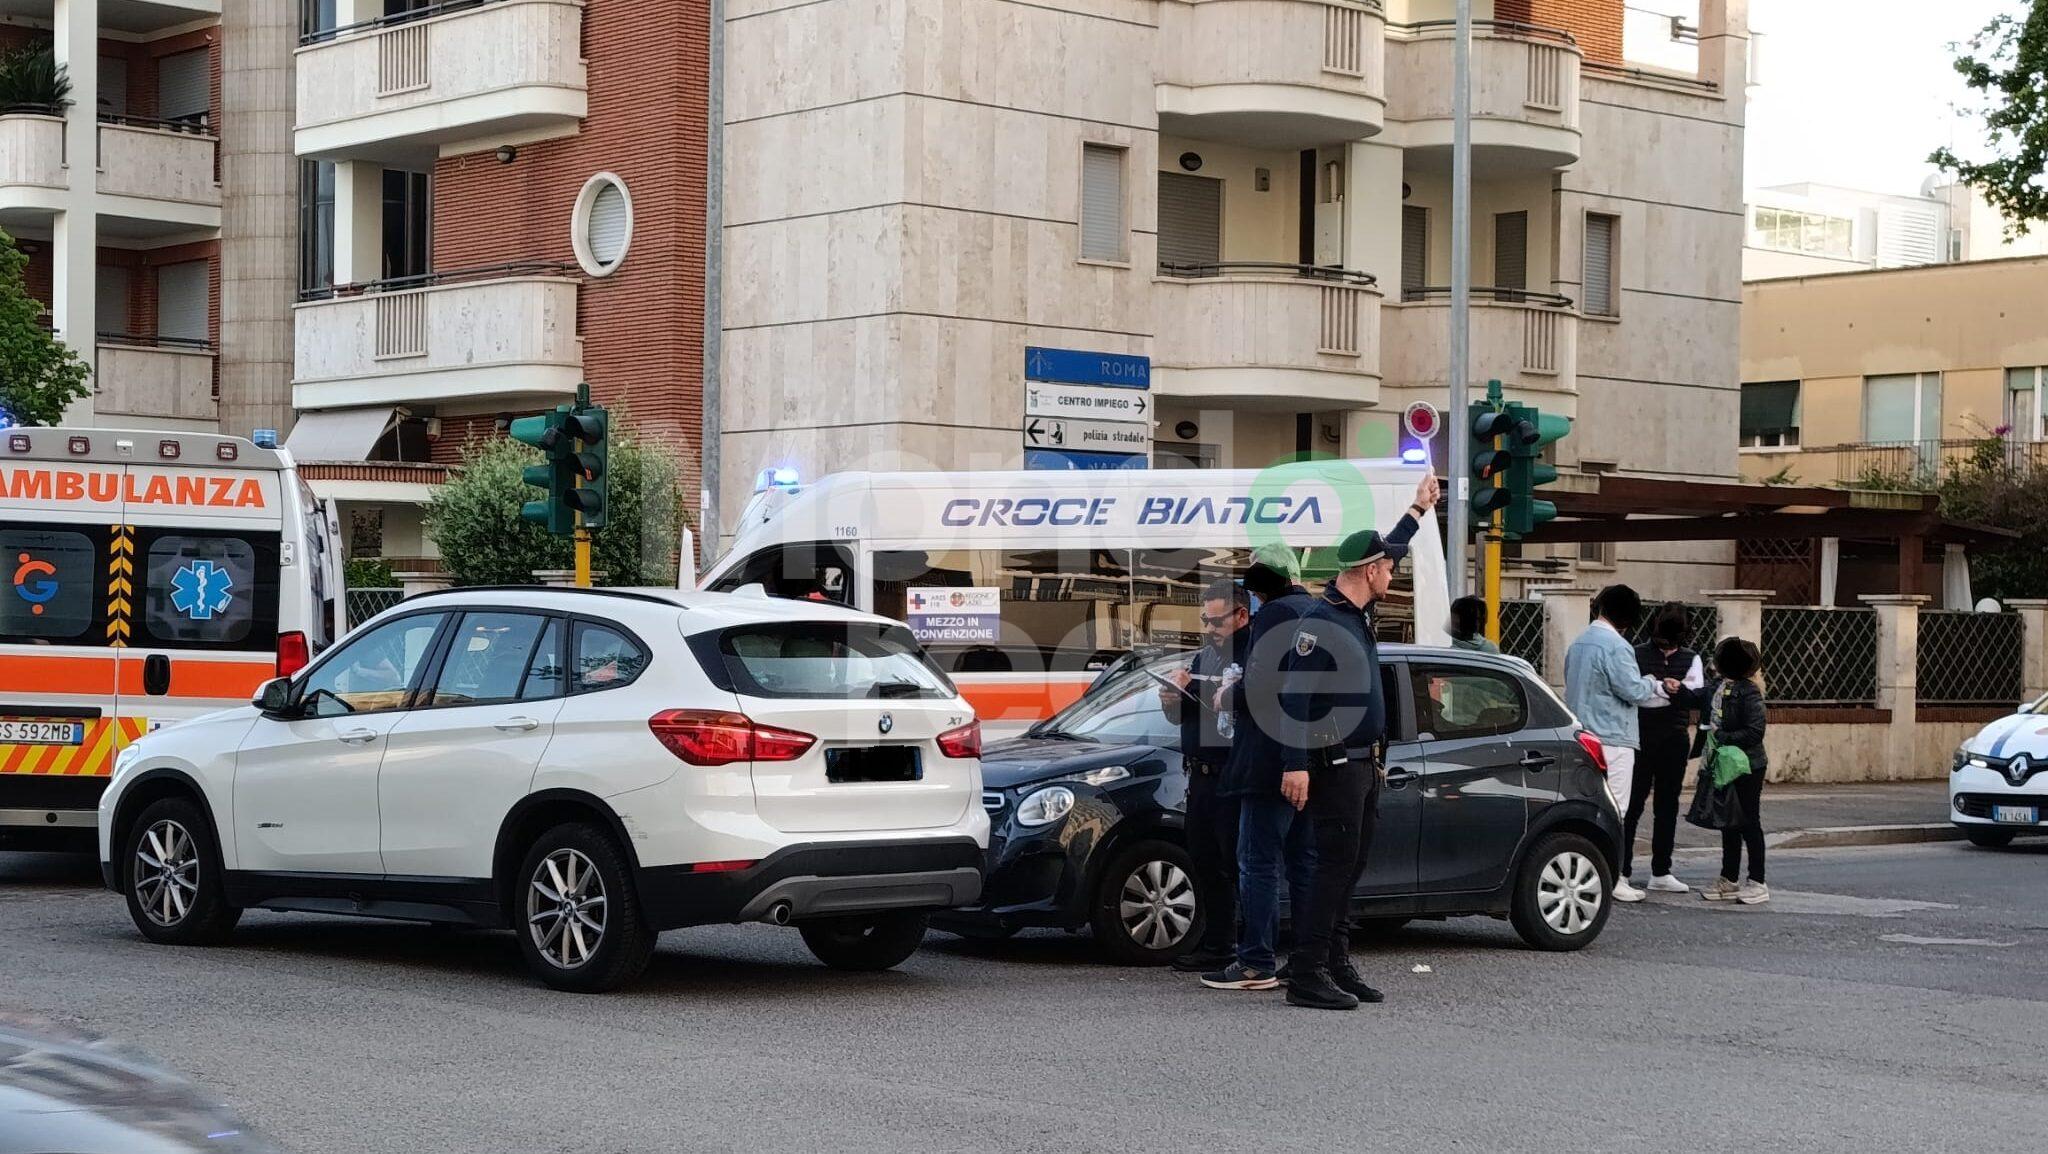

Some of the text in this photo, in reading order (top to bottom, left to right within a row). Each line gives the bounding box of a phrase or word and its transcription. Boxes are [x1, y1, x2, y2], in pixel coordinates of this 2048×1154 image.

[1101, 361, 1146, 378] ROMA
[1058, 396, 1092, 407] CENTRO
[1094, 398, 1129, 409] IMPIEGO
[1083, 430, 1144, 443] polizia stradale
[0, 469, 265, 508] MBULANZA
[941, 496, 1323, 527] CROCE BIANCA
[835, 526, 858, 537] 1160
[926, 617, 979, 627] MEZZO IN
[913, 629, 993, 639] CONVENZIONE
